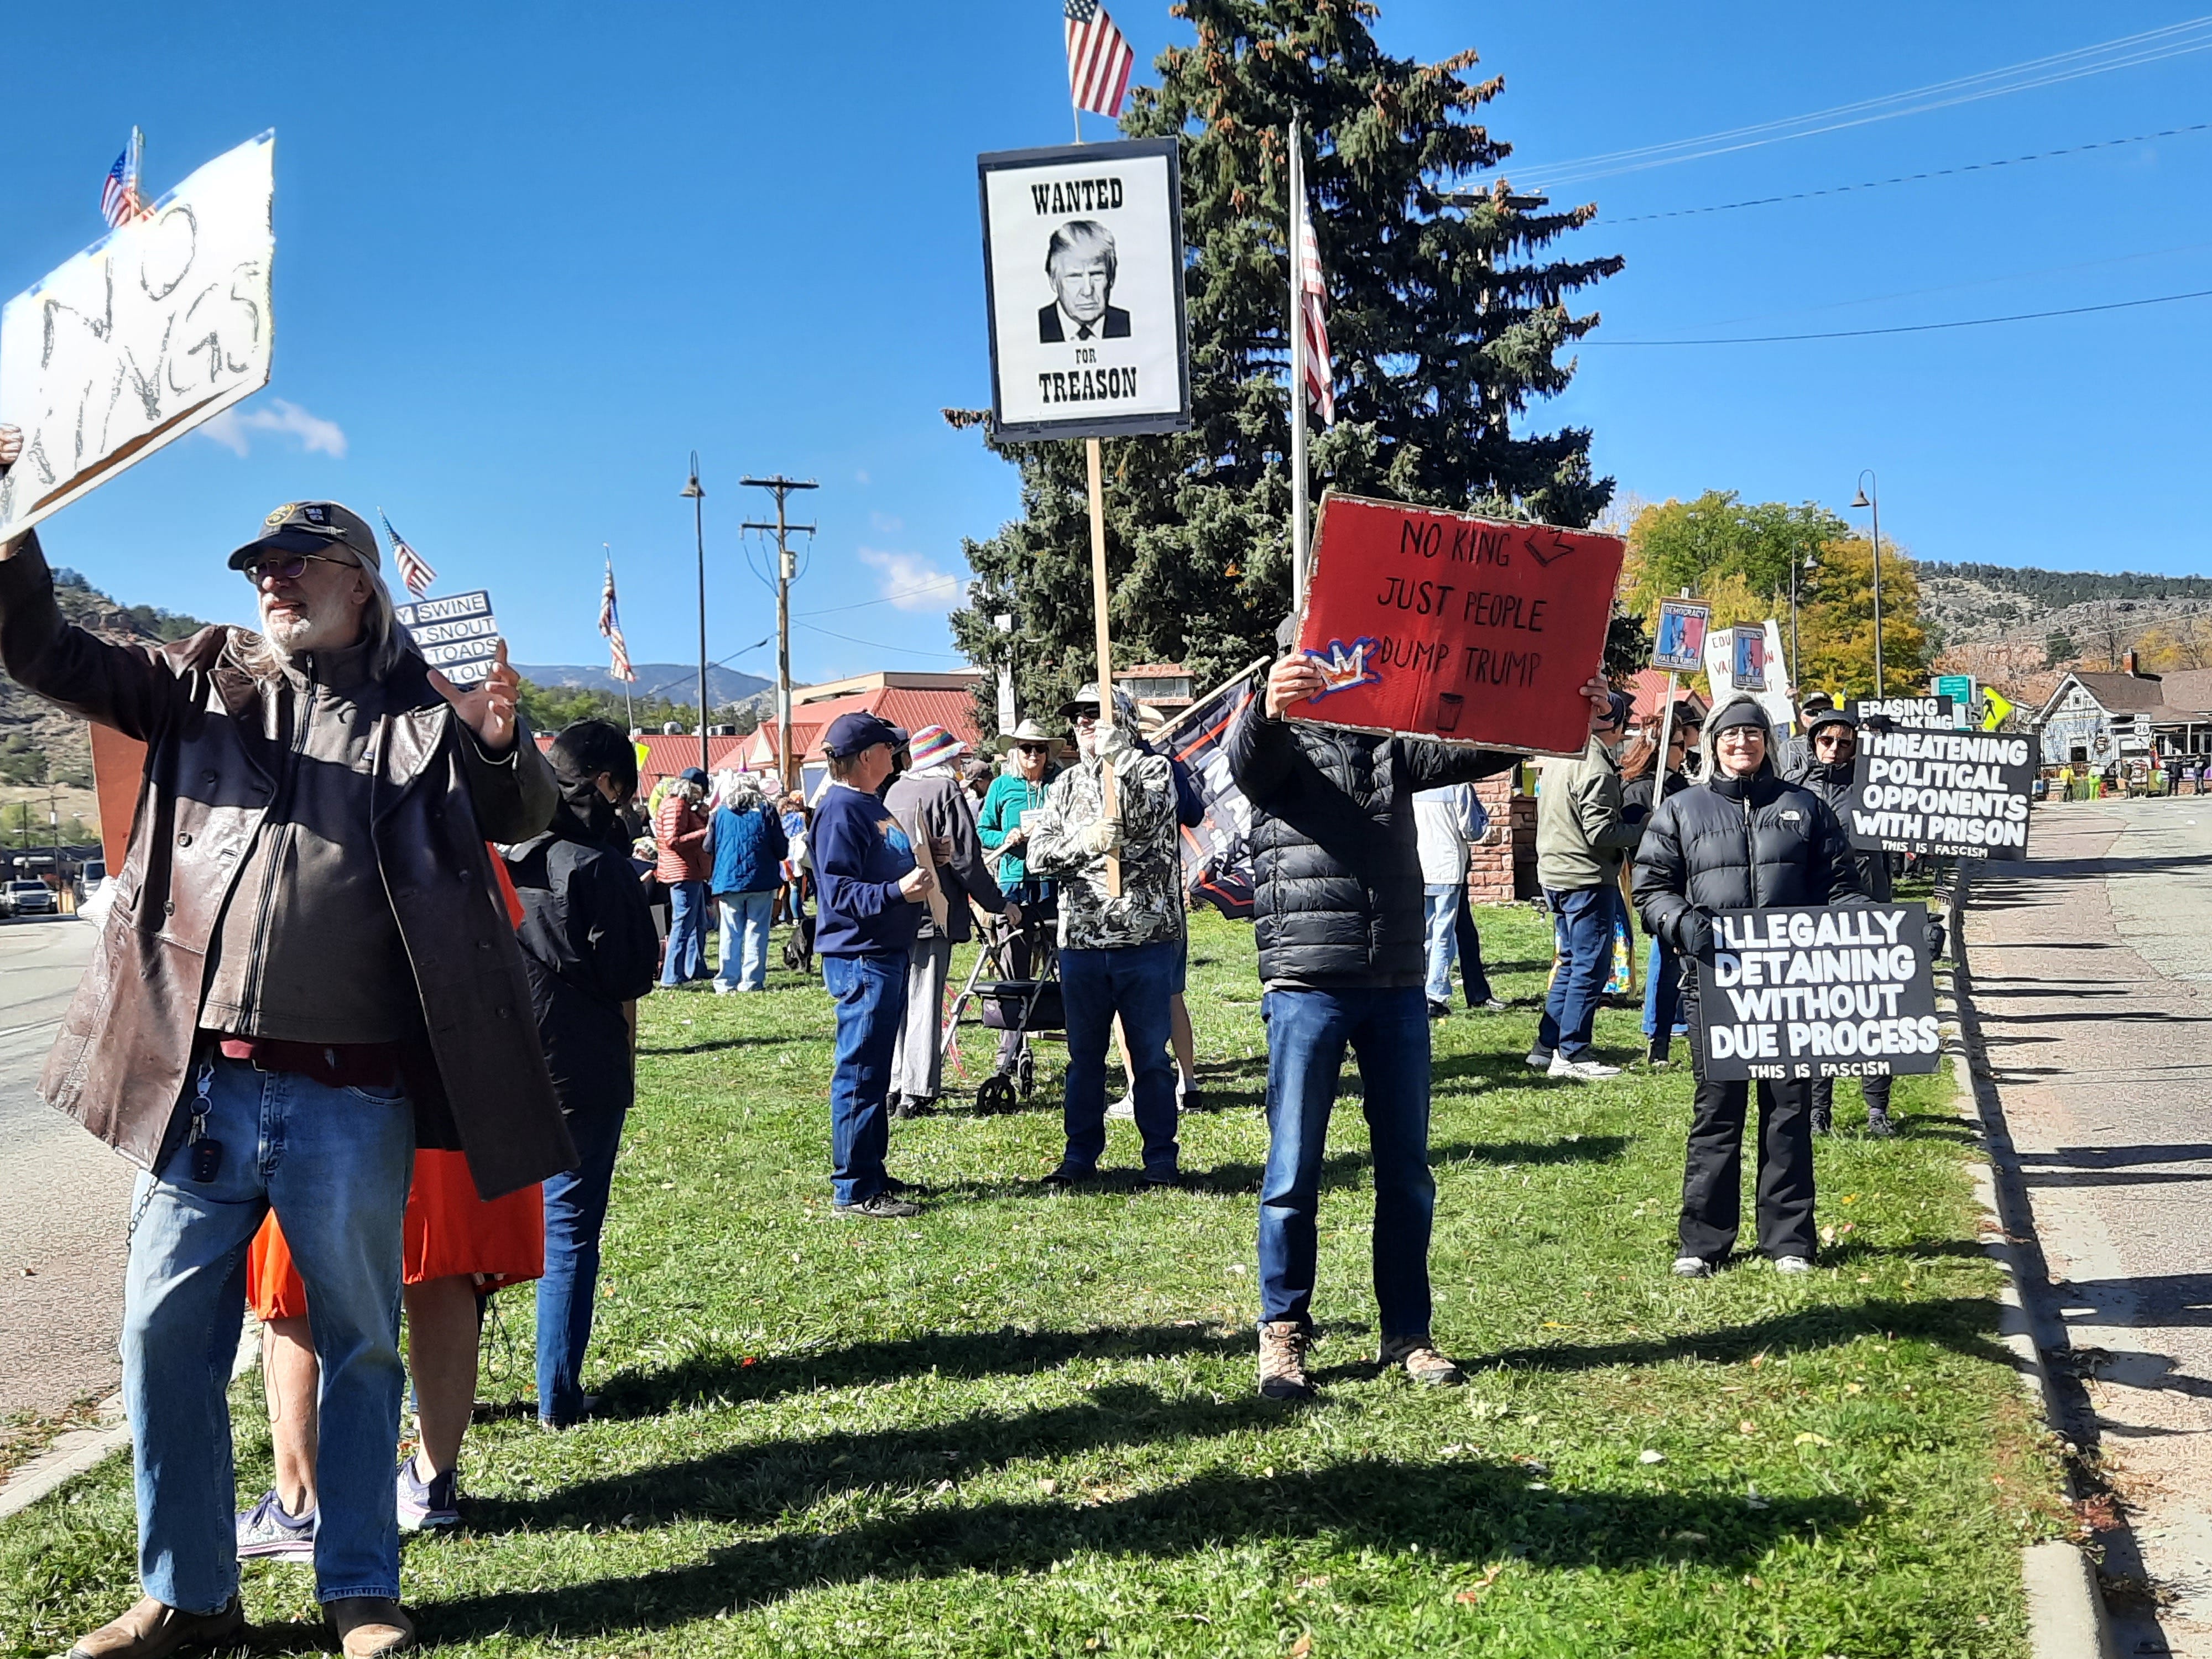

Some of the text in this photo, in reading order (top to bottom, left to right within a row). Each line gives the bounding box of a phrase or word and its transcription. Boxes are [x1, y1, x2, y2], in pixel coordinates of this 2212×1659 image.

[1030, 178, 1124, 216] WANTED
[41, 203, 197, 371] NO
[1075, 348, 1097, 364] FOR
[1038, 367, 1137, 404] TREASON
[1400, 519, 1510, 566] NO KING
[419, 596, 485, 619] SWINE
[1378, 576, 1547, 632] JUST PEOPLE
[426, 618, 495, 641] SNOUT
[432, 638, 498, 662] TOADS
[1380, 635, 1541, 687] DUMP TRUMP
[1857, 698, 1938, 718] ERASING
[1857, 731, 2028, 766] THREATENING
[1868, 758, 2008, 791] POLITICAL
[1863, 784, 2028, 821] OPPONENTS
[1852, 810, 2026, 847] WITH PRISON
[1881, 839, 1989, 859] THIS IS FASCISM
[1712, 910, 1908, 950] ILLEGALLY
[1714, 945, 1916, 988] DETAINING
[1726, 984, 1905, 1022] WITHOUT
[1710, 1016, 1939, 1060] DUE PROCESS
[1747, 1061, 1891, 1079] THIS IS FASCISM
